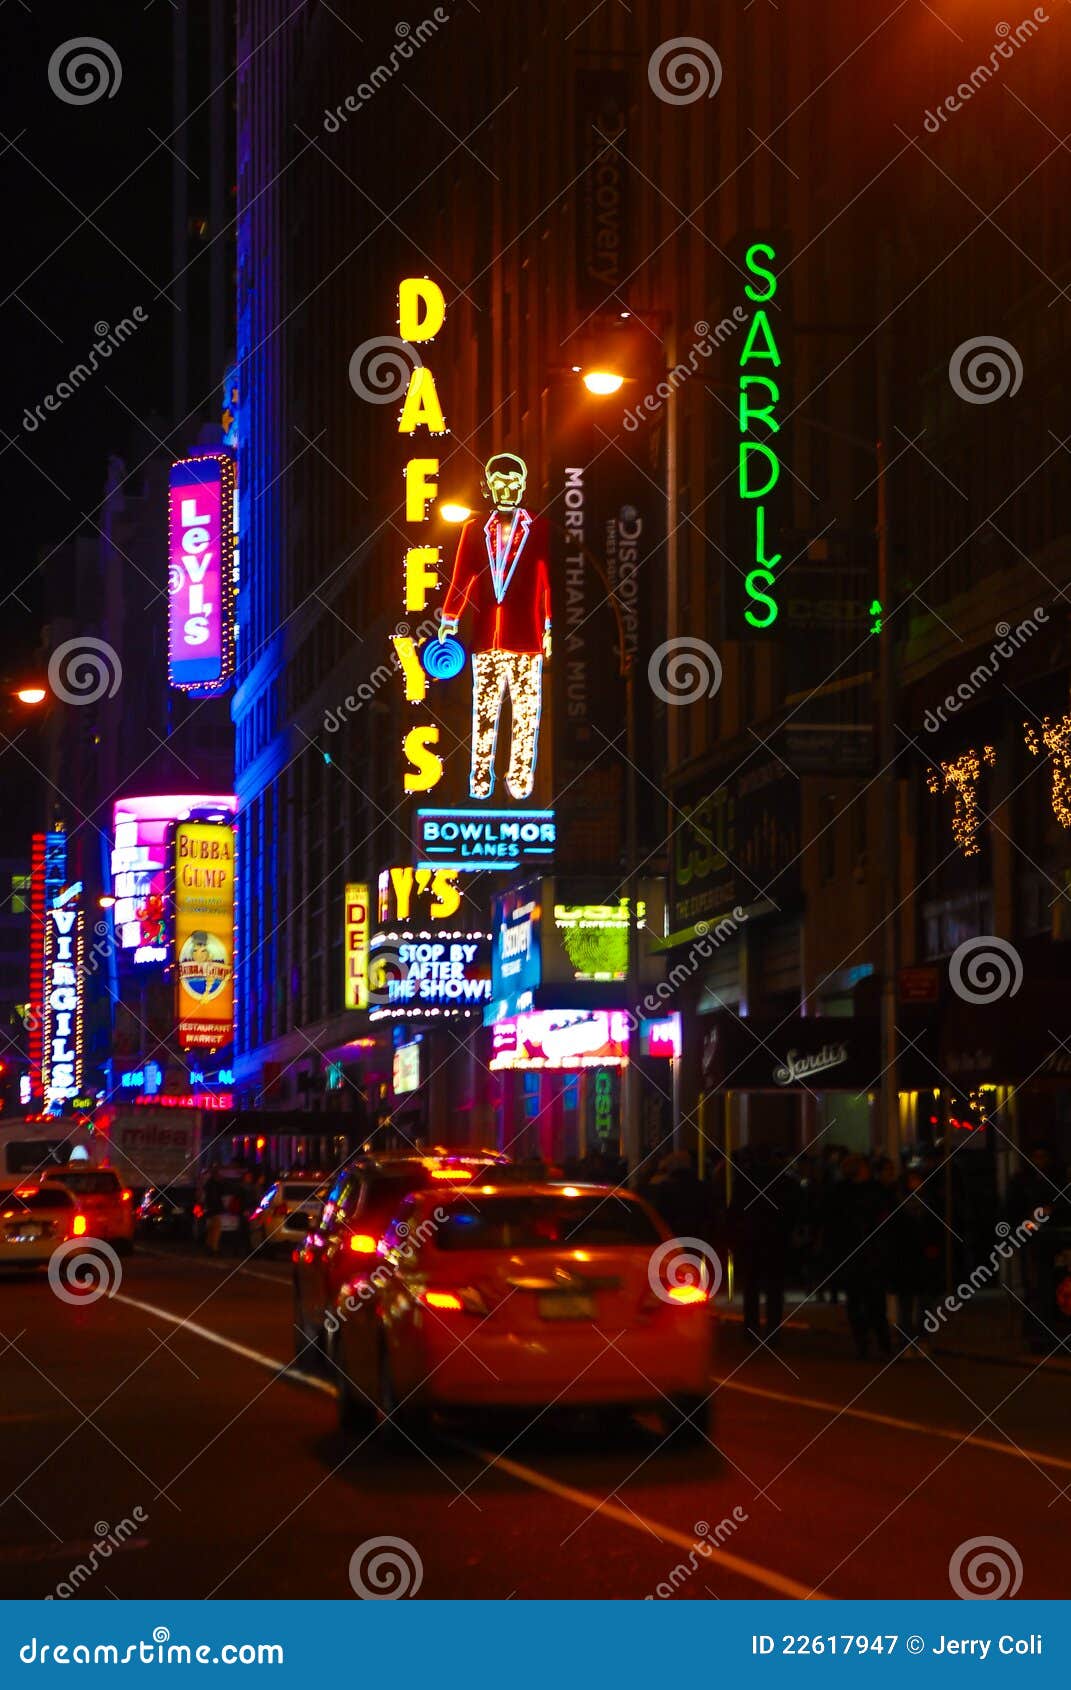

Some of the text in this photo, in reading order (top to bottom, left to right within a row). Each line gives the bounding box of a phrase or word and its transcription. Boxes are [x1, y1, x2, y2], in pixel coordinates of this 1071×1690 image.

[565, 467, 583, 544] MORE
[565, 552, 584, 625] THAN
[567, 661, 587, 717] MUS
[424, 822, 556, 842] BOWLMOR
[180, 835, 231, 860] BUBBA
[461, 843, 520, 857] LANES
[182, 864, 226, 888] GUMP
[347, 904, 366, 1005] DELI
[399, 944, 477, 962] STOP BY
[408, 961, 465, 980] AFTER
[388, 979, 492, 998] THE SHOW!
